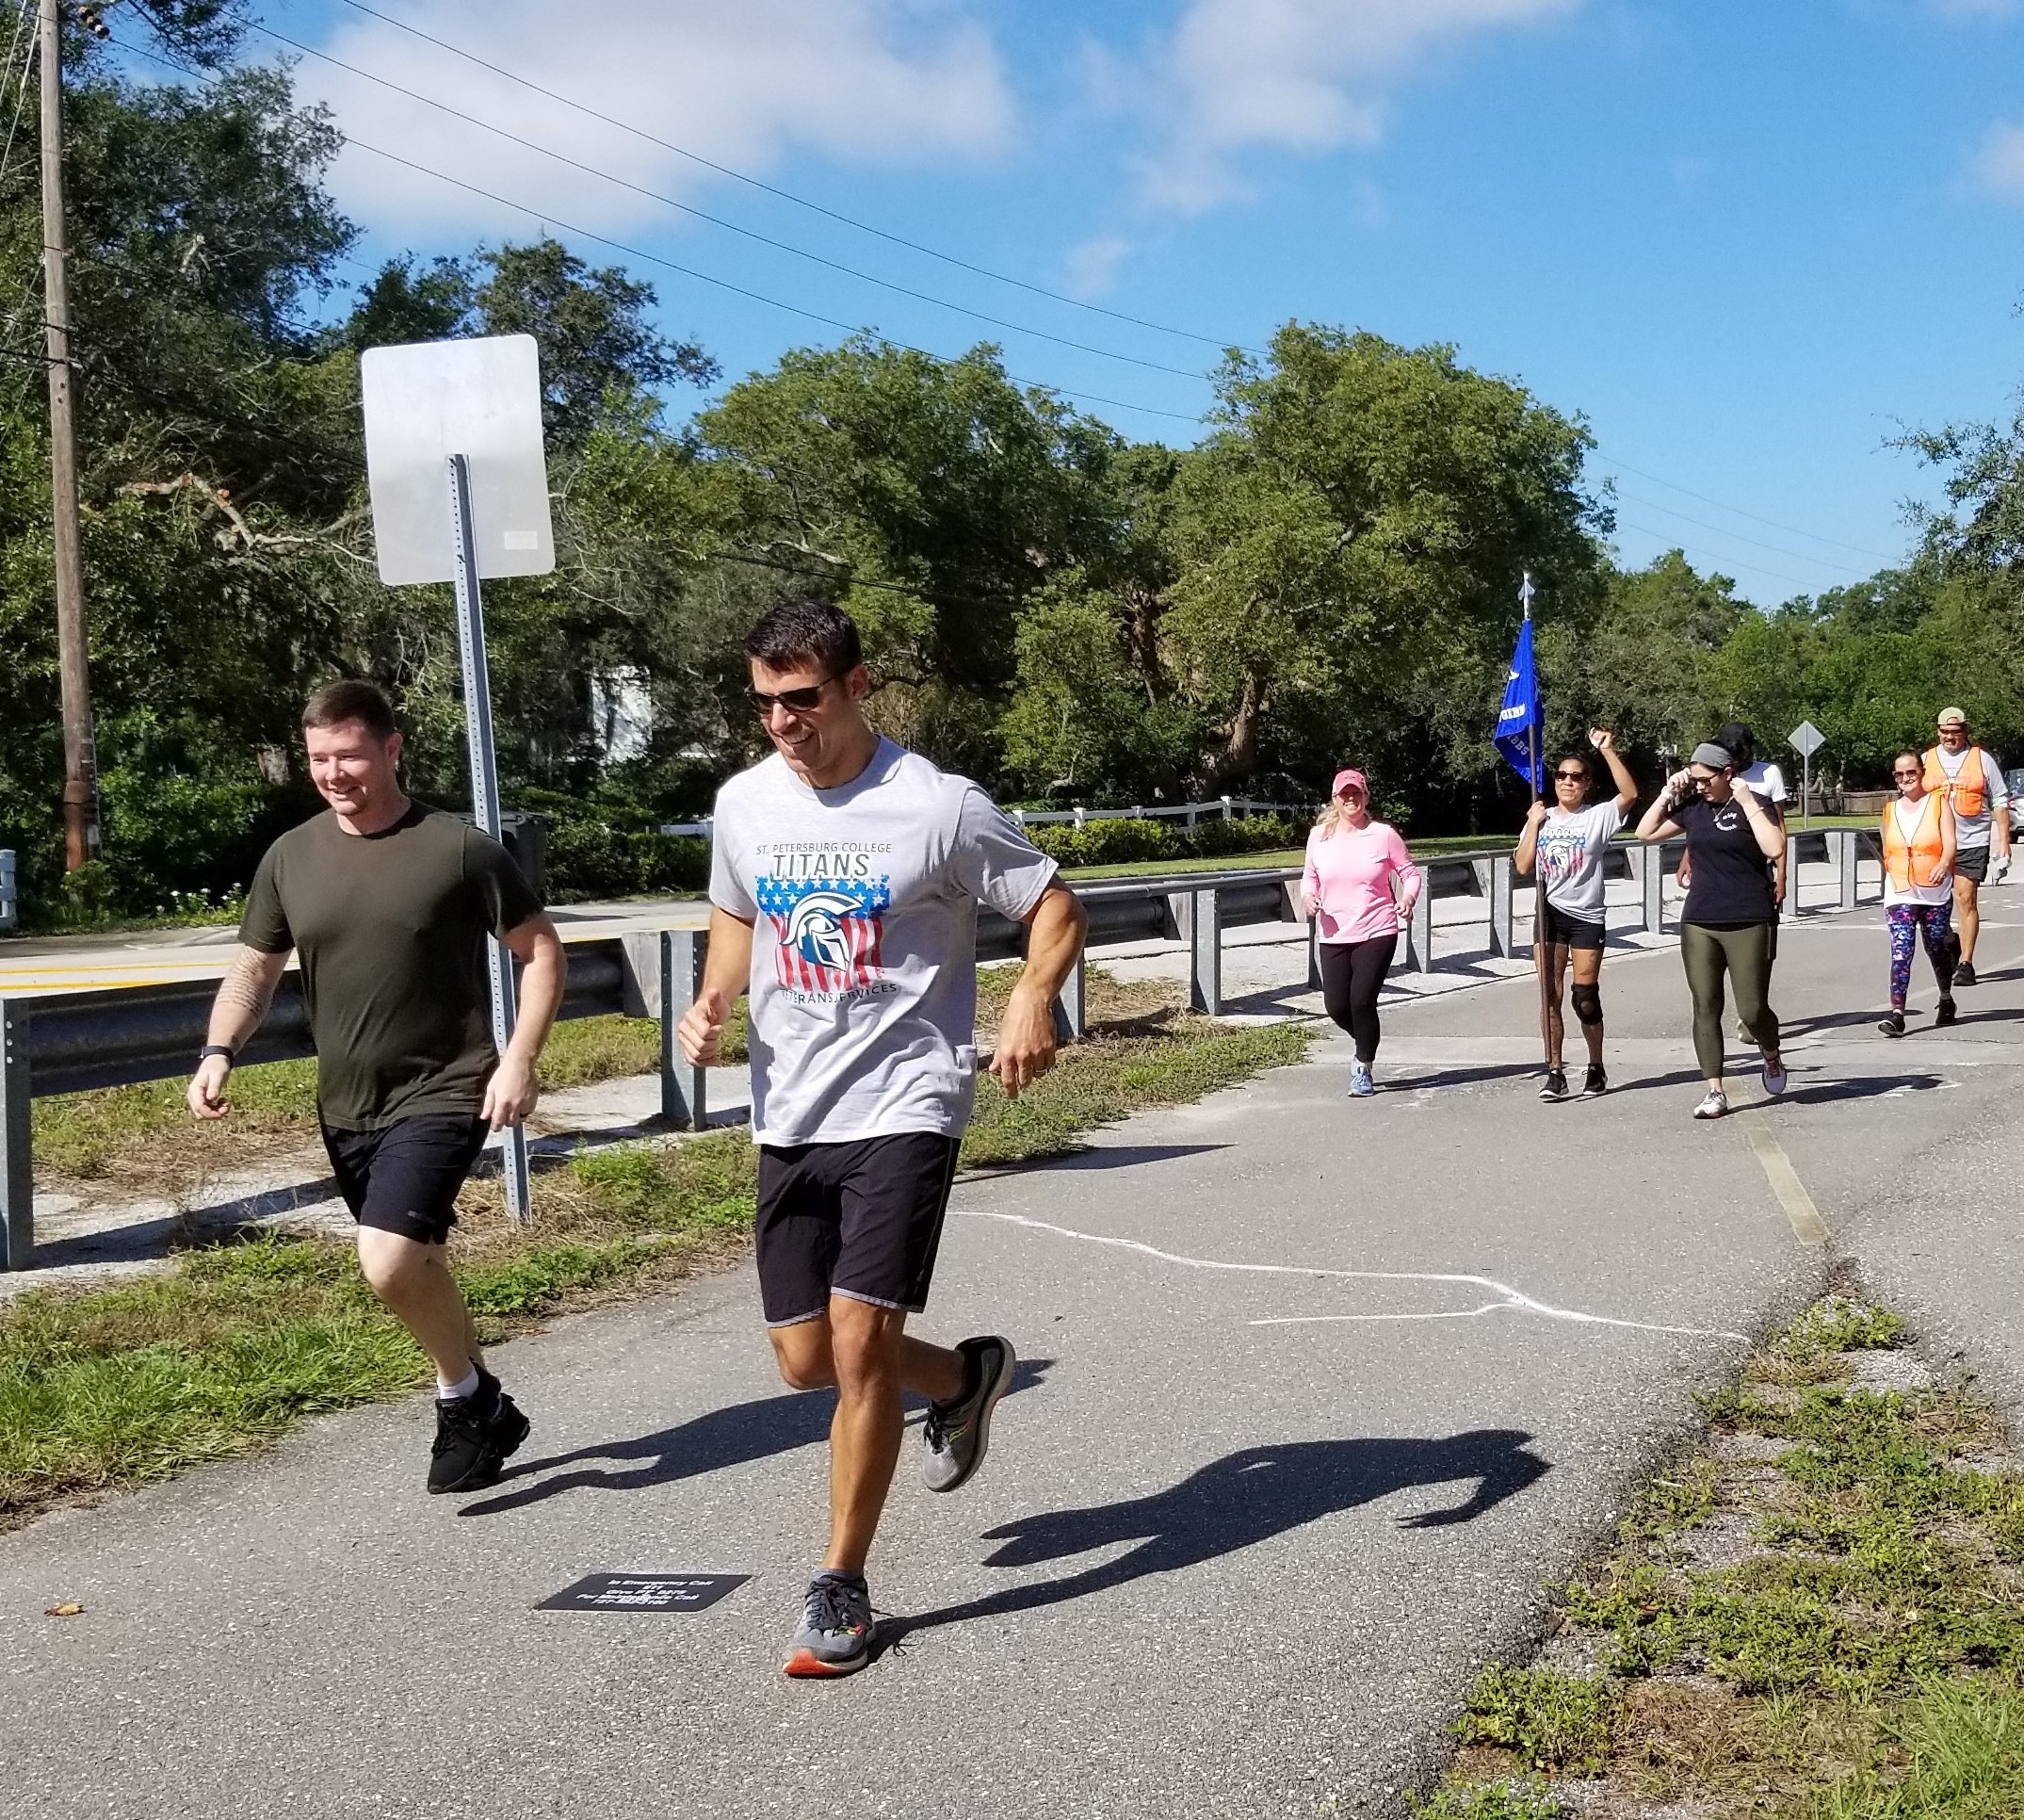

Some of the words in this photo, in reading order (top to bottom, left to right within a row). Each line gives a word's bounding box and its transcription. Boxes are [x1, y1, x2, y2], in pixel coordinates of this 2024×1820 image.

[756, 844, 769, 855] ST.
[772, 842, 838, 853] PETERSBURG
[841, 842, 892, 853] COLLEGE
[771, 853, 870, 880] TITANS
